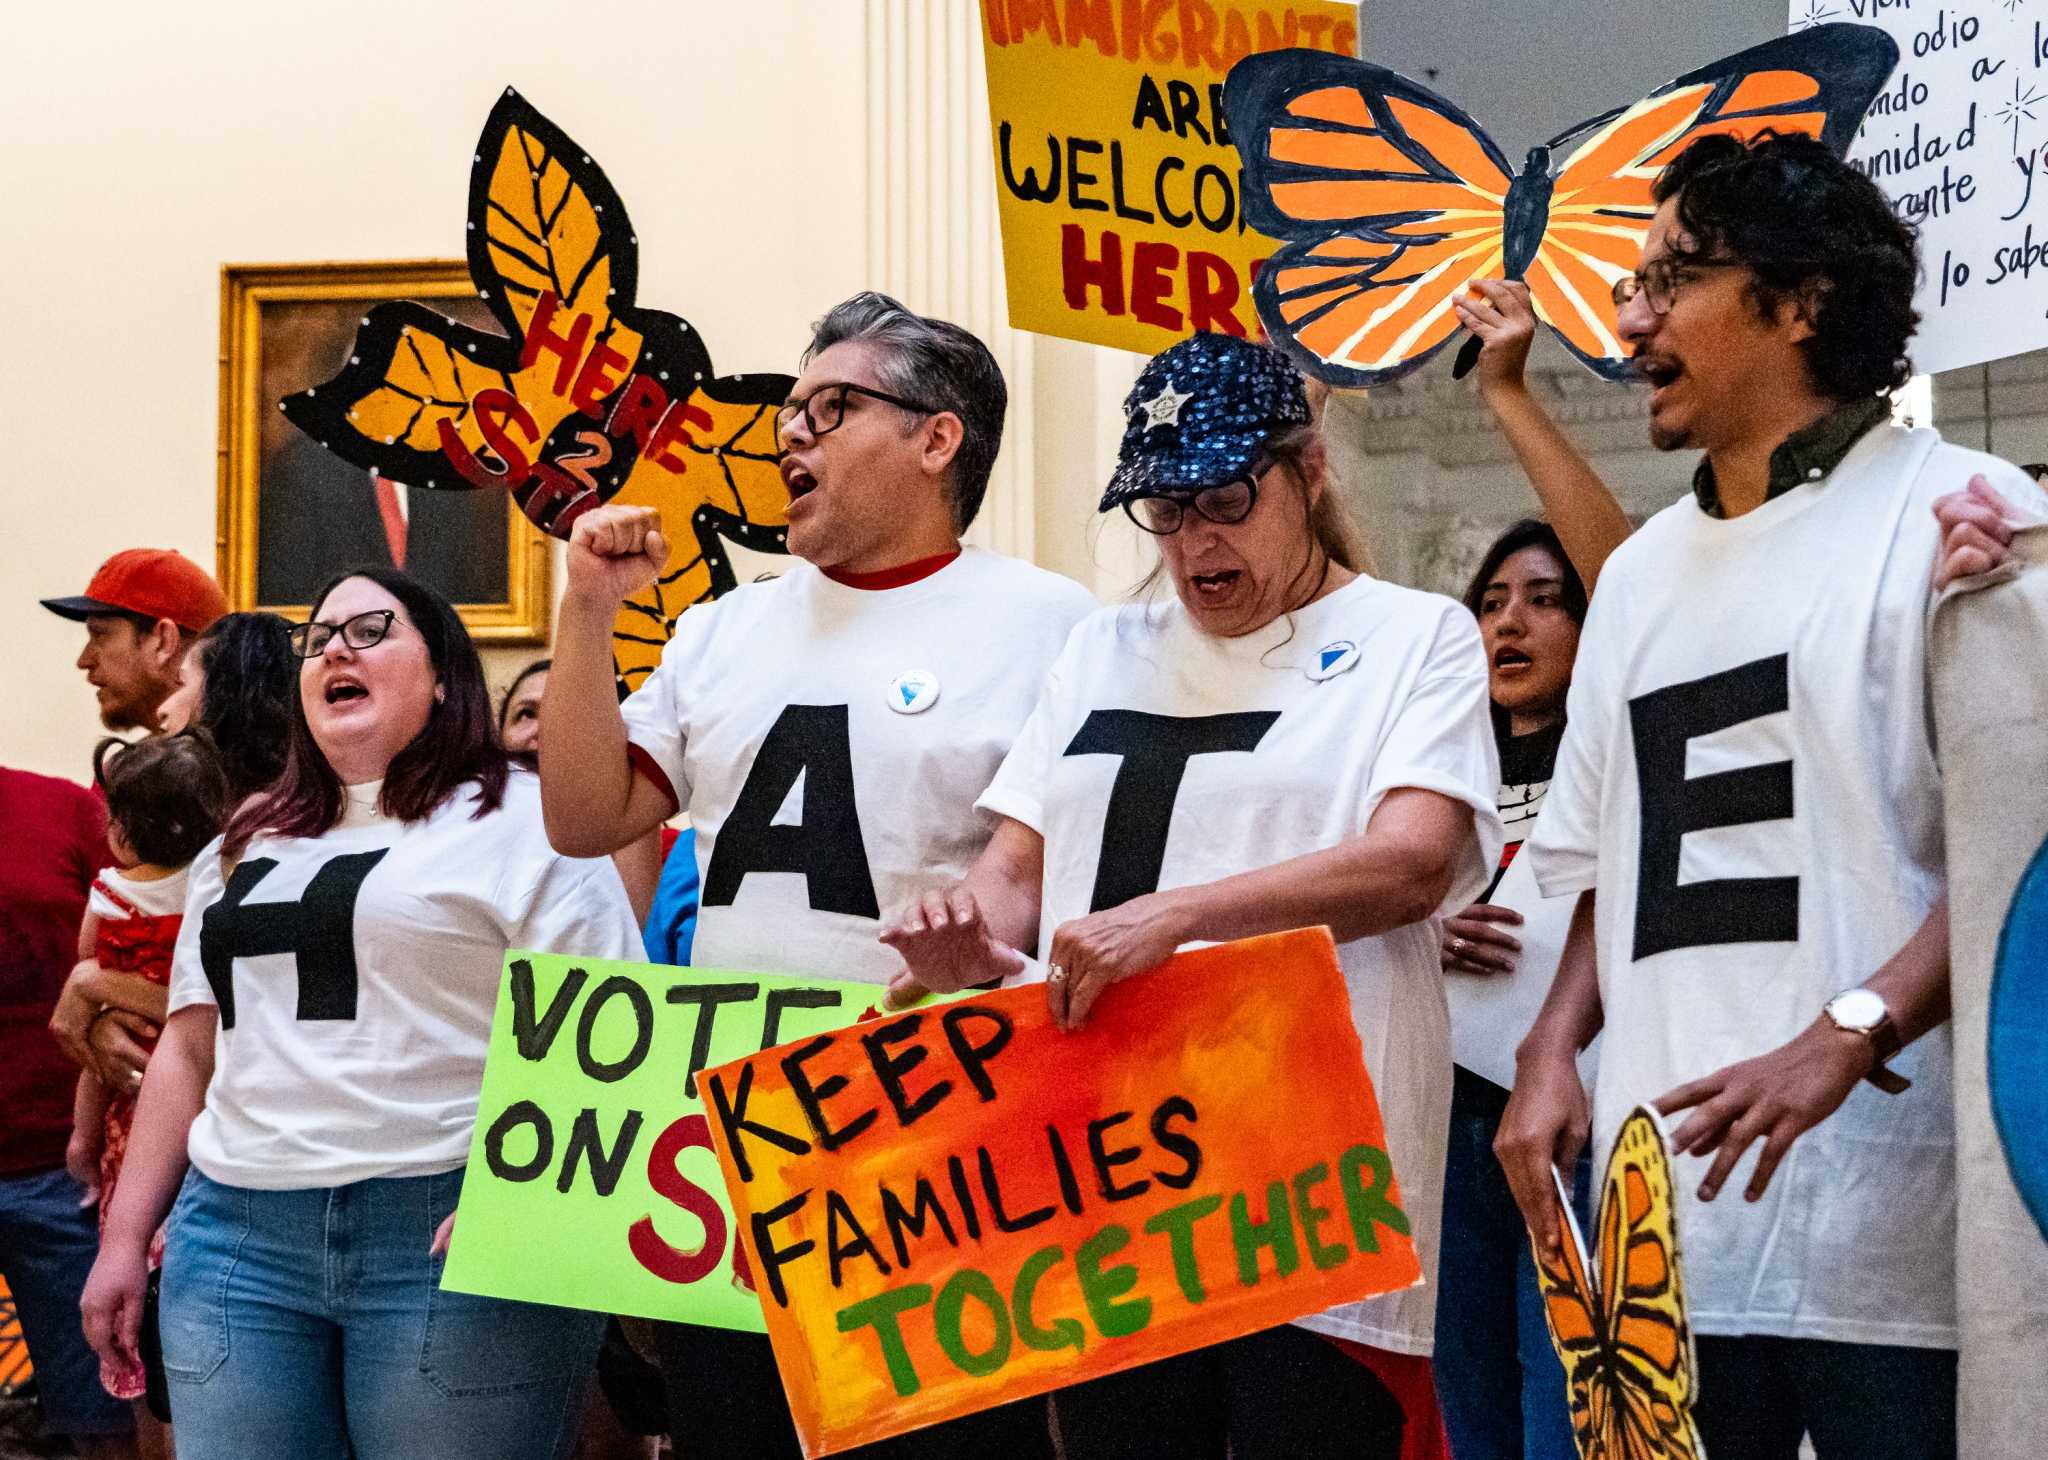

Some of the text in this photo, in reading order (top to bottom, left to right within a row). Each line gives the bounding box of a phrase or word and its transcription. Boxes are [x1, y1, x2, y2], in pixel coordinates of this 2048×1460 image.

[1869, 74, 1928, 117] ndo
[1972, 57, 2005, 82] a
[1914, 10, 1979, 58] odio
[999, 120, 1246, 236] WELCO
[1849, 102, 1976, 178] unidad
[1894, 166, 1976, 217] rante
[1062, 223, 1272, 340] HER
[1941, 251, 1969, 307] lo
[520, 289, 713, 475] HERE
[553, 431, 613, 493] 2
[702, 704, 881, 920] A
[1062, 709, 1282, 915] T
[1629, 652, 1799, 962] E
[200, 847, 390, 1031] H
[708, 1006, 1012, 1182] KEEP
[485, 1100, 758, 1296] ON S
[751, 1096, 1203, 1308] FAMILIES
[837, 1144, 1412, 1397] TOGETHER
